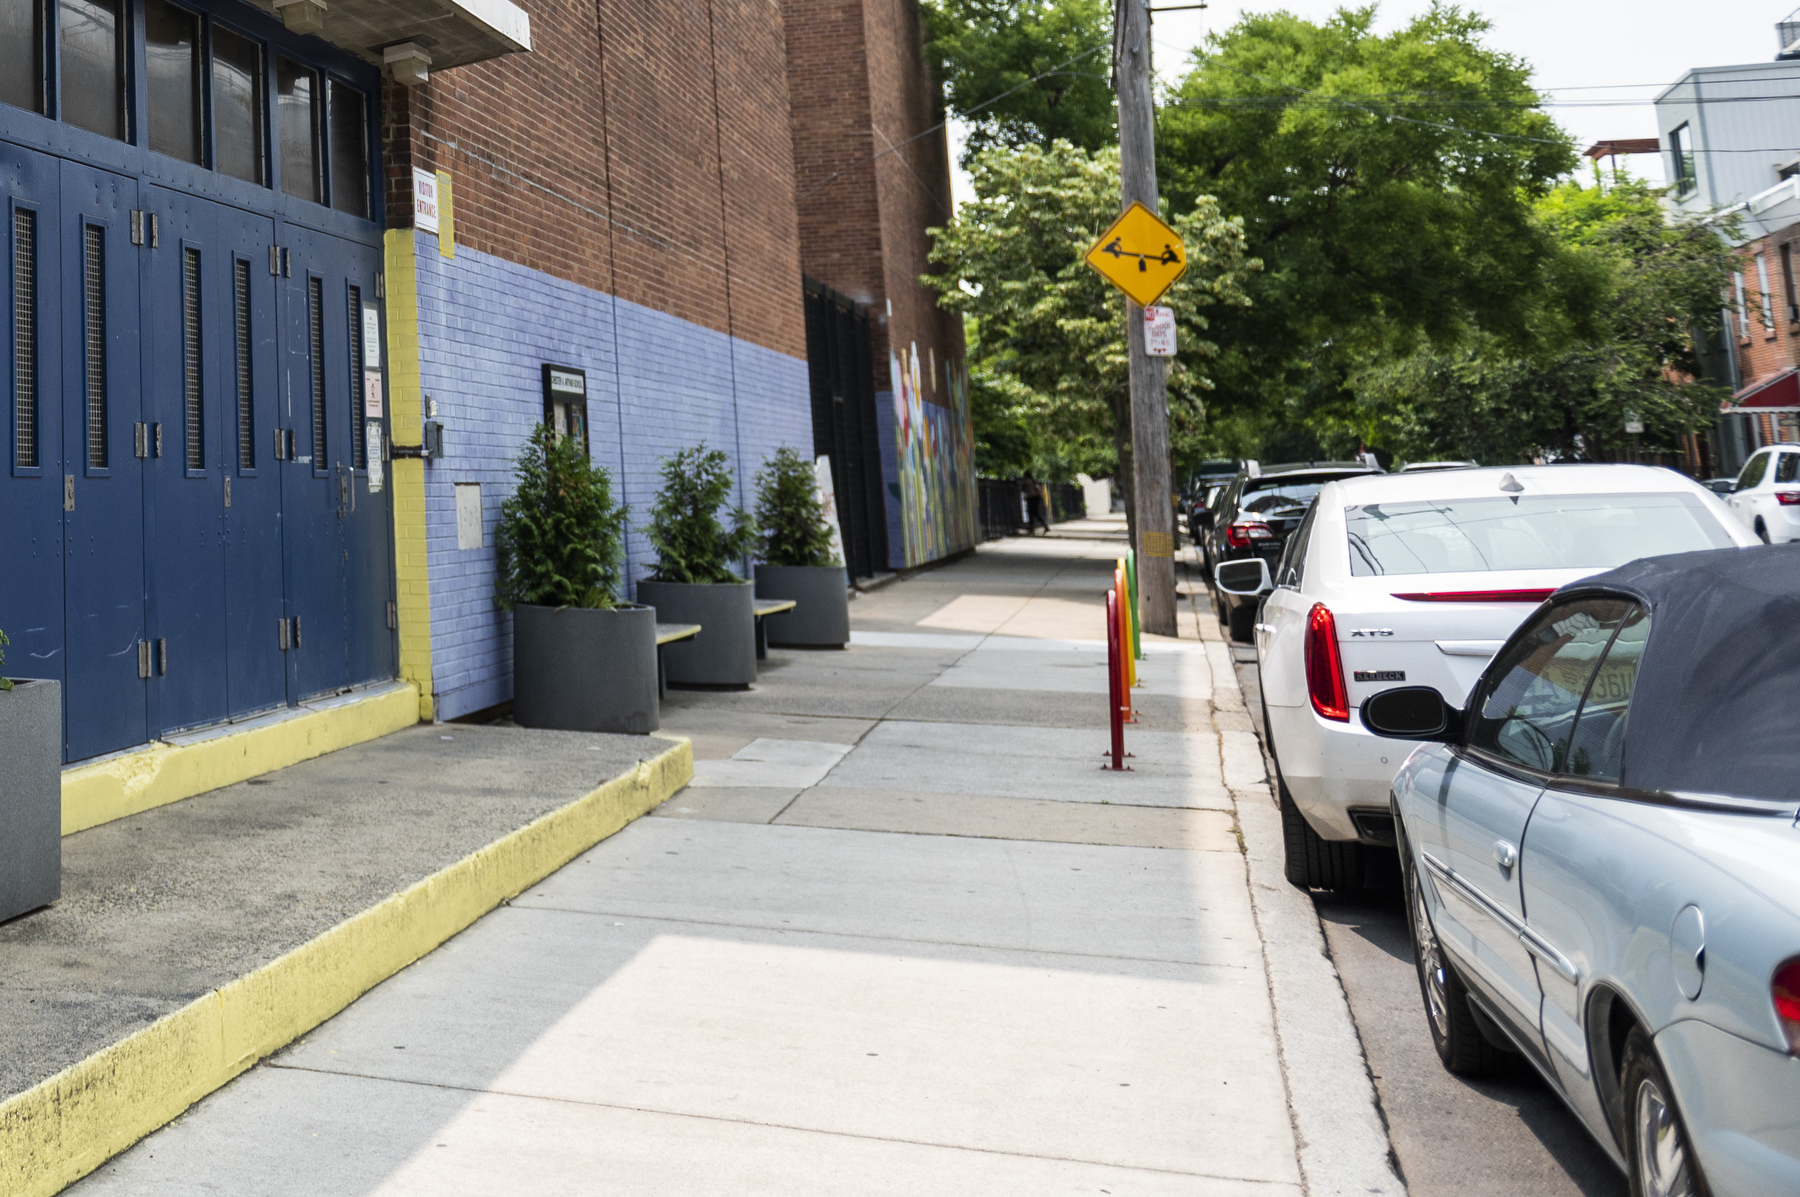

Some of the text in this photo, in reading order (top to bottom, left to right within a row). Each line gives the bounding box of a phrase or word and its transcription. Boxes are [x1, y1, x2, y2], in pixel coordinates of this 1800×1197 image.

[417, 179, 434, 199] VISITOR
[416, 198, 437, 219] ENTRANCE
[1350, 628, 1394, 637] XTS
[1357, 672, 1403, 681] KERBECK
